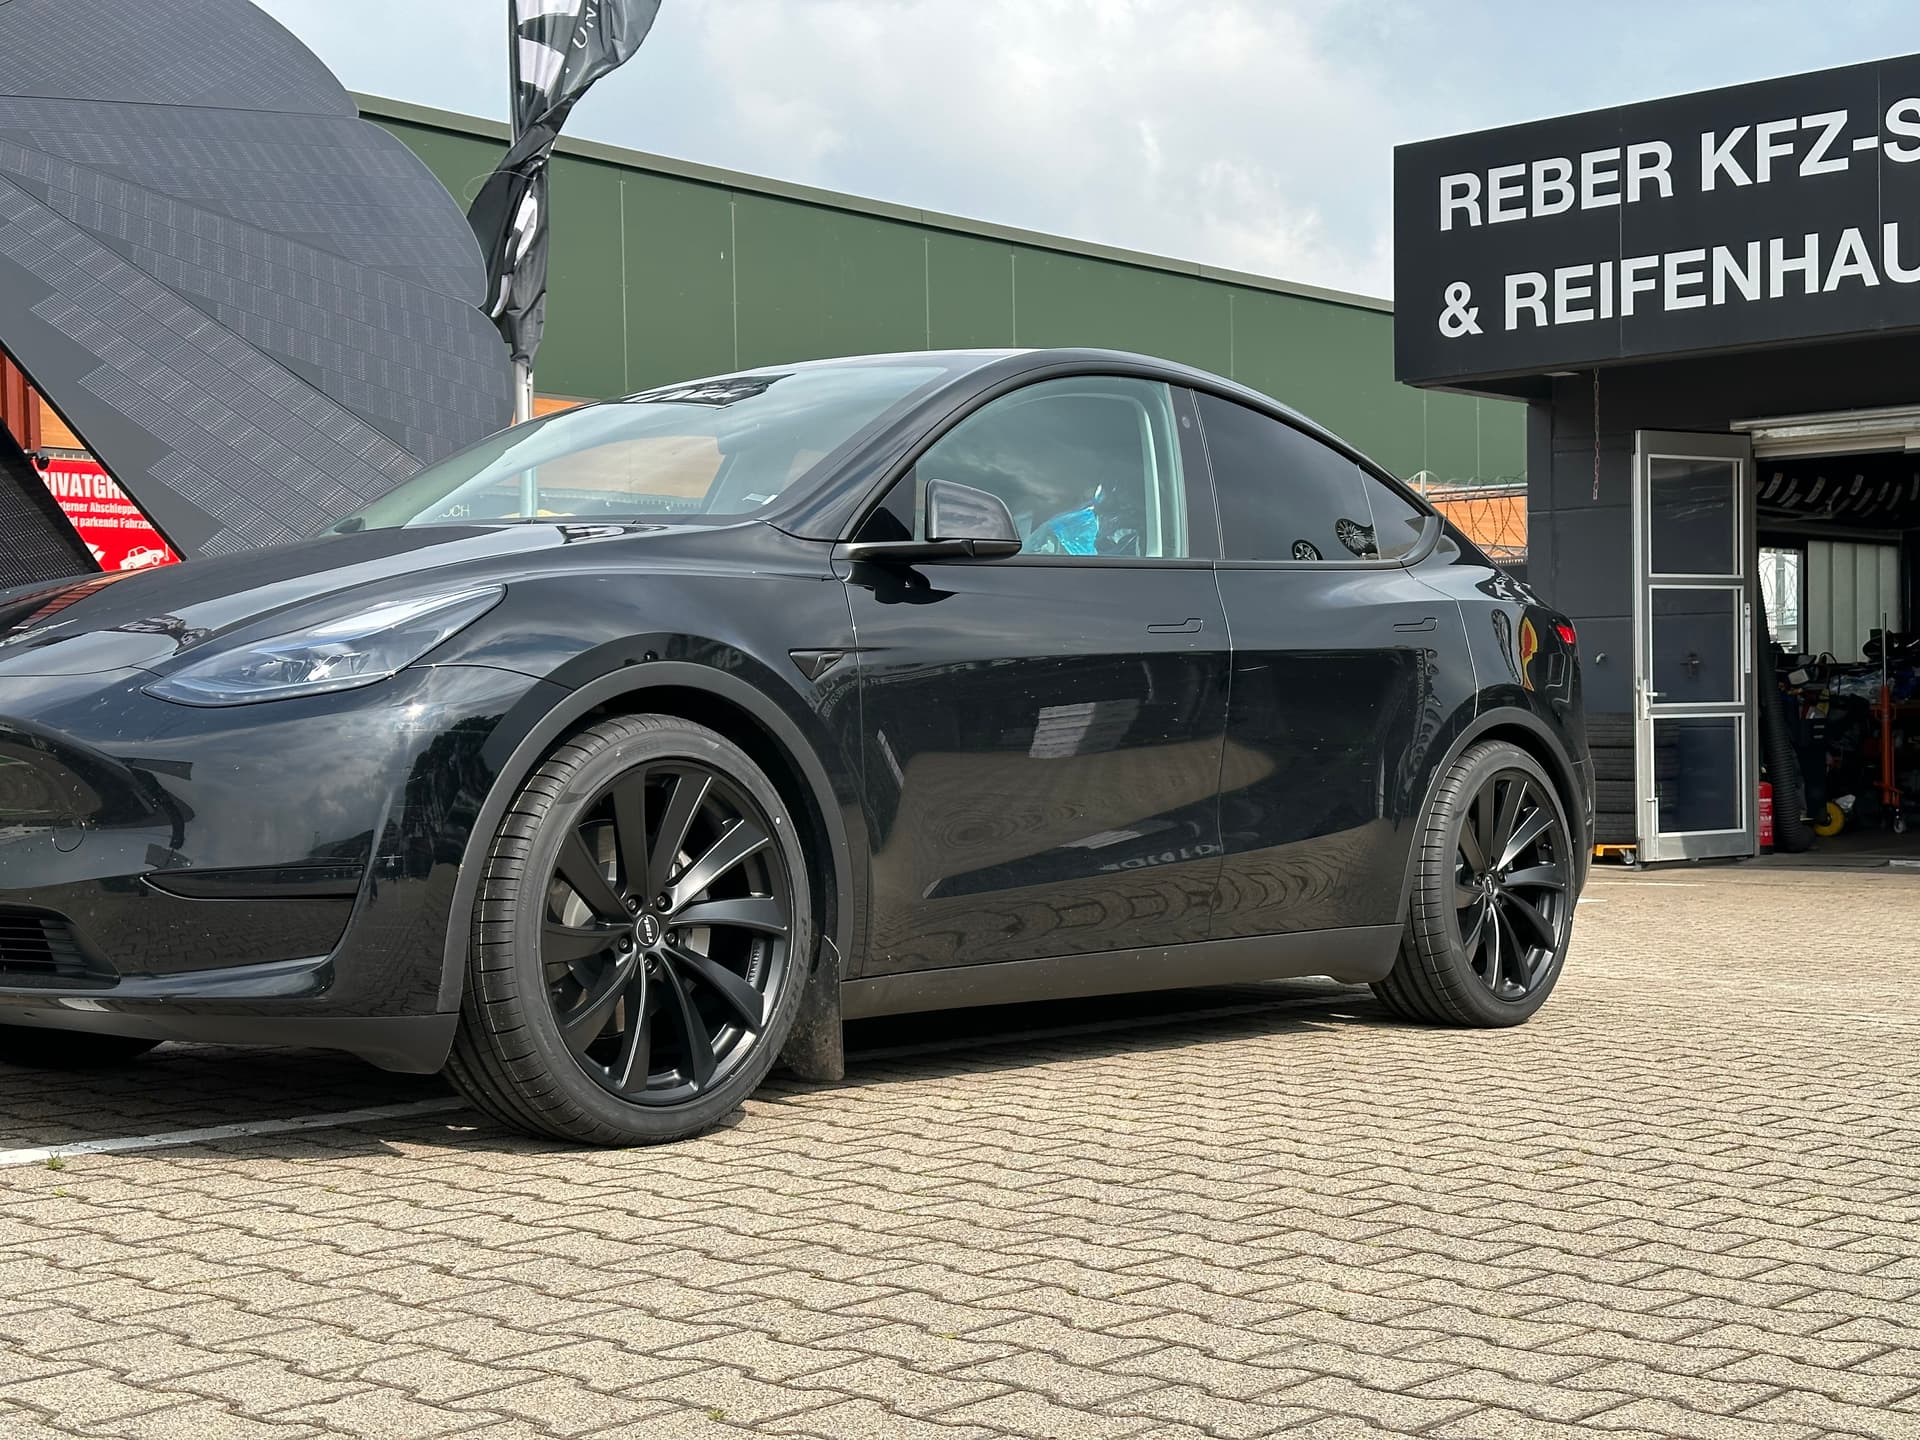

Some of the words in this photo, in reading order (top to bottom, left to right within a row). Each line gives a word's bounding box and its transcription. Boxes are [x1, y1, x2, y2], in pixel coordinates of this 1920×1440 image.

[1440, 140, 1674, 231] REBER
[1701, 97, 1920, 192] KFZ-S
[1438, 281, 1484, 338] &
[1504, 222, 1920, 330] REIFENHAU
[80, 517, 118, 528] parkende
